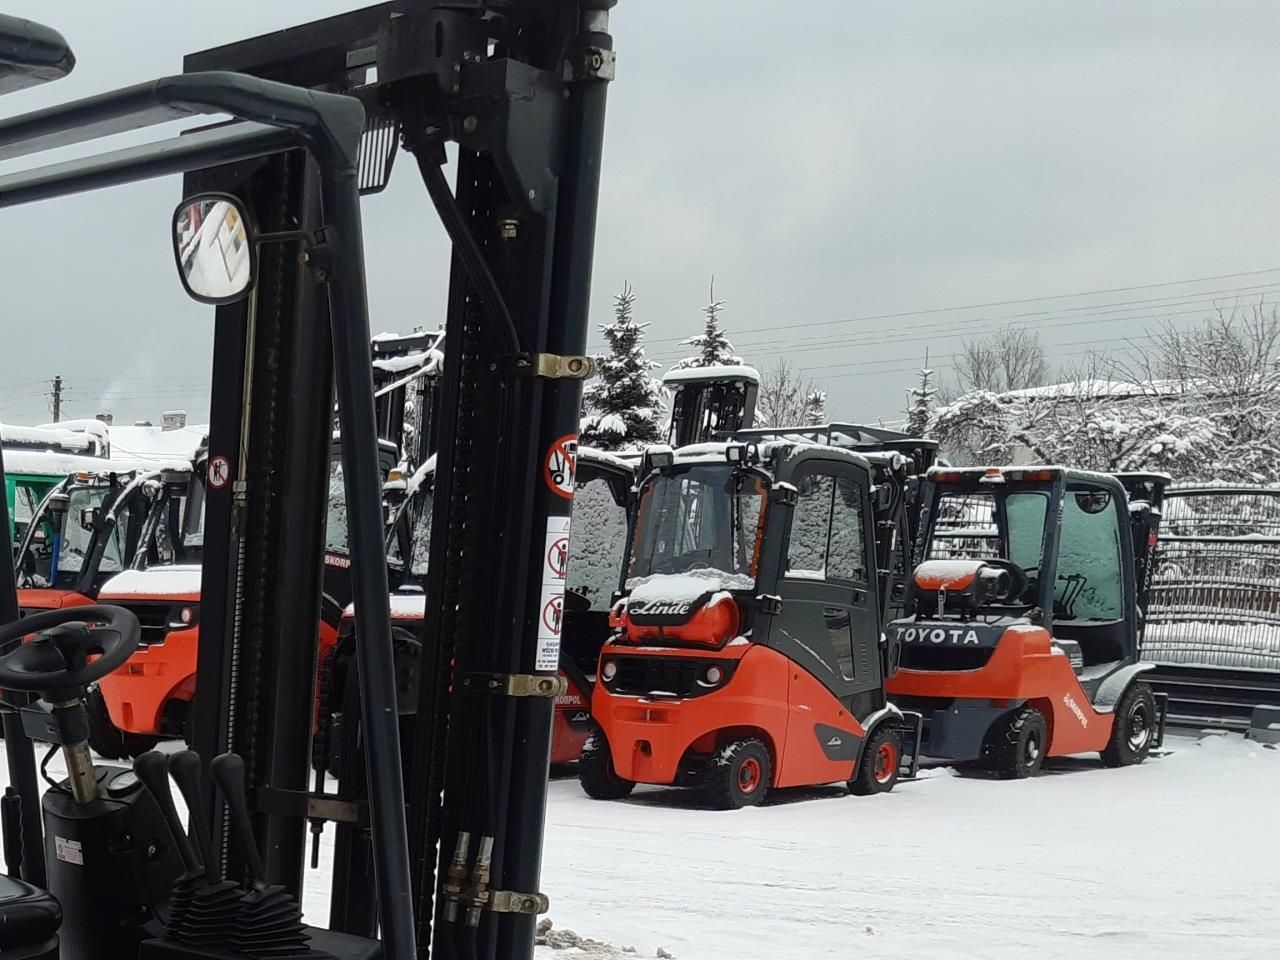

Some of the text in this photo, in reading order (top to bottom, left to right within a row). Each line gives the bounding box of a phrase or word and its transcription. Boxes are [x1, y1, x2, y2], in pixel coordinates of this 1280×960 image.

[324, 554, 351, 569] SKORP
[629, 599, 690, 615] Linde
[896, 627, 980, 644] TOYOTA
[554, 695, 581, 705] KORPOL
